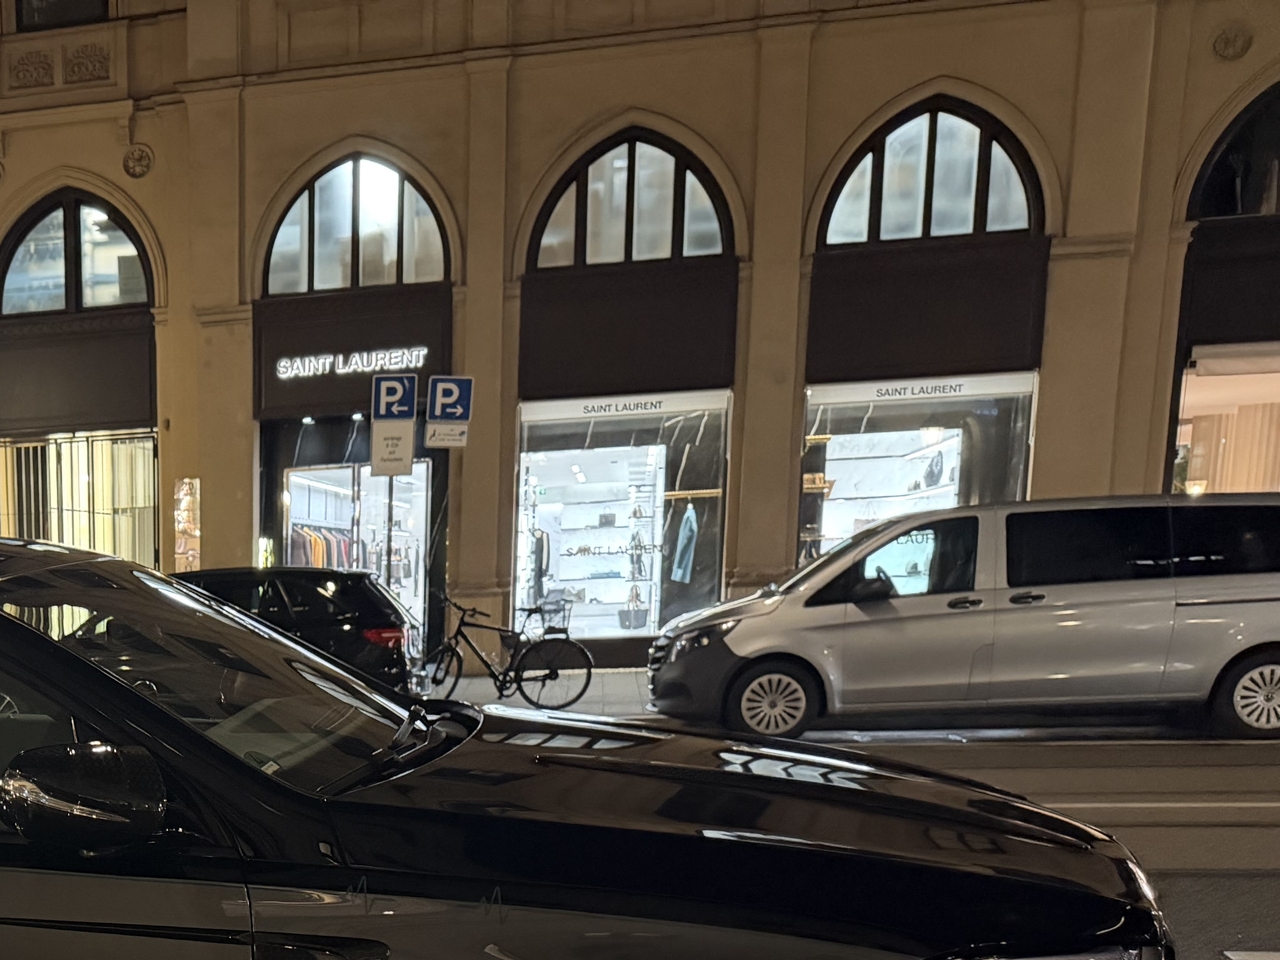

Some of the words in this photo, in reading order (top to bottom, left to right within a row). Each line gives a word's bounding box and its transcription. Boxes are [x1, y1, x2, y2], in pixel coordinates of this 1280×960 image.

[277, 355, 333, 379] SAINT
[335, 347, 428, 374] LAURENT
[379, 381, 404, 415] P
[434, 382, 460, 416] P
[876, 387, 909, 398] SAINT
[911, 384, 964, 395] LAURENT
[583, 404, 612, 414] SAINT
[615, 401, 663, 412] LAURENT
